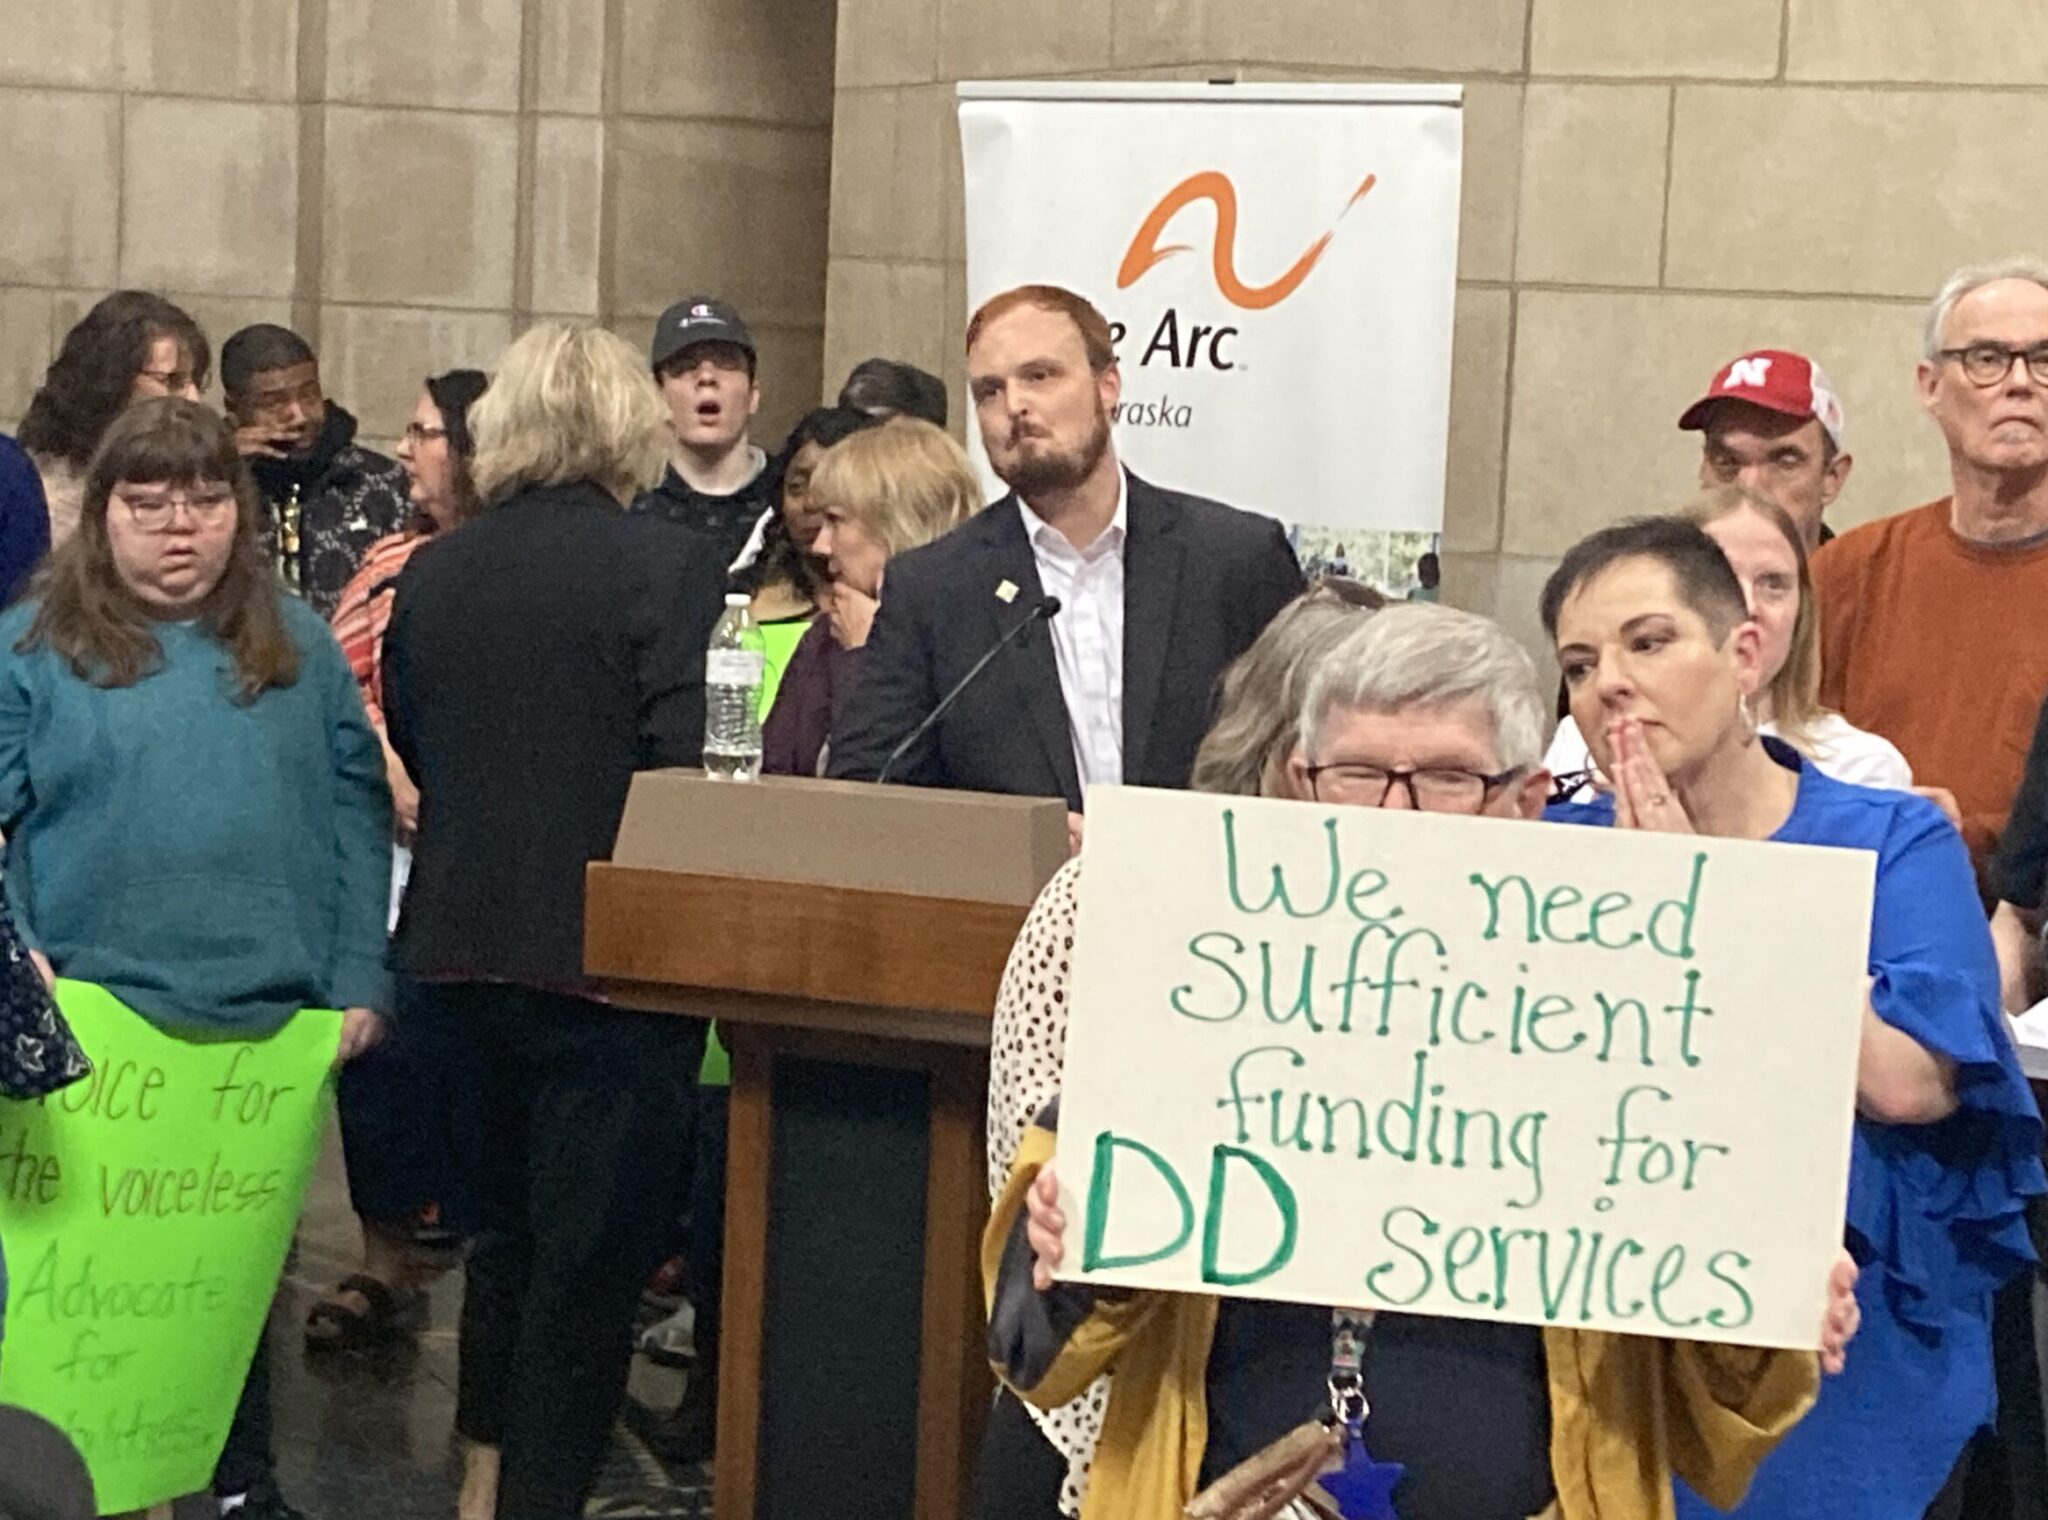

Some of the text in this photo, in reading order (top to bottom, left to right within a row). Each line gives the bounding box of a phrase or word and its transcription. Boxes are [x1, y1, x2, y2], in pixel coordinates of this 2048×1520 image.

[1140, 308, 1239, 371] Arc
[1722, 357, 1773, 389] N
[1111, 394, 1192, 428] raska
[1221, 808, 1709, 961] We need
[38, 1044, 297, 1126] oice for
[1216, 1045, 1731, 1210] funding for
[99, 1151, 282, 1219] voiceless
[1081, 1130, 1299, 1289] DD
[15, 1238, 228, 1322] Advocate
[53, 1329, 139, 1383] for
